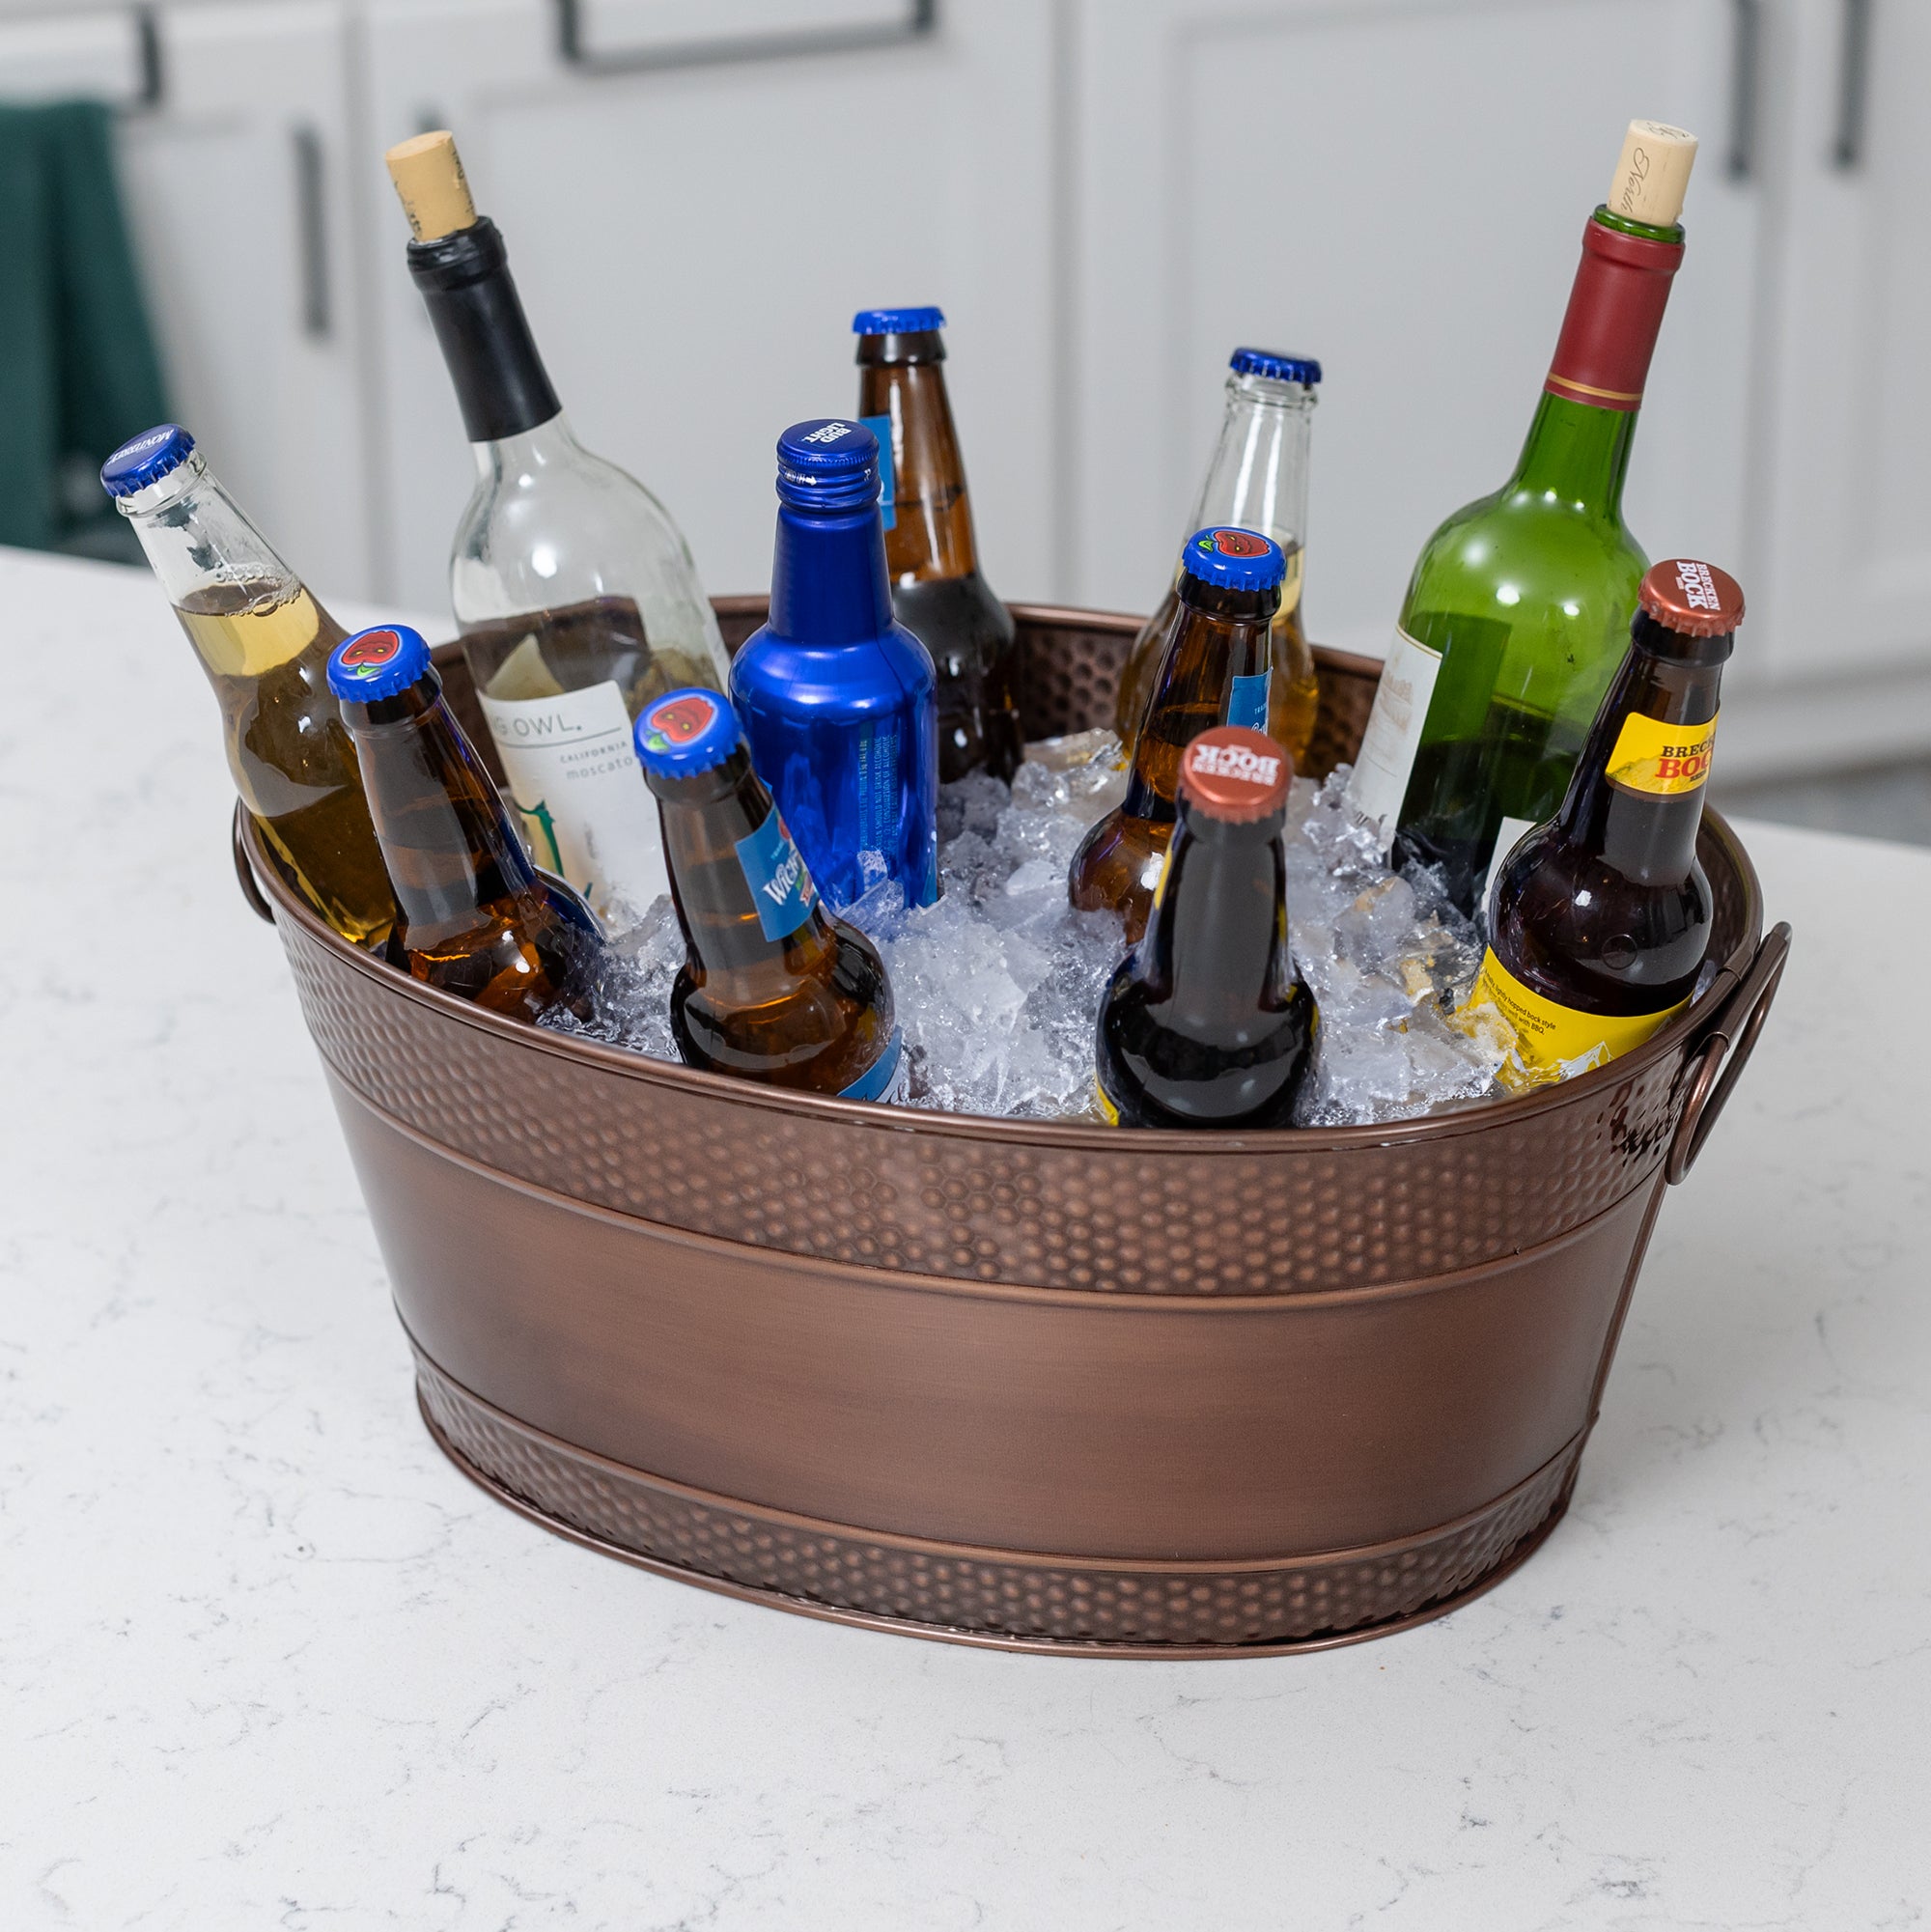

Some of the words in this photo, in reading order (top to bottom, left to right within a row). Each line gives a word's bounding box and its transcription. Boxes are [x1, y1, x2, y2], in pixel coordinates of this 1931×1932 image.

[801, 422, 846, 443] LIGHT
[820, 429, 852, 443] BUD
[1676, 561, 1708, 609] BOCK
[1696, 563, 1721, 611] BRECKEN
[560, 741, 627, 764] CALIFORNIA
[566, 756, 633, 780] moscato
[1508, 997, 1527, 1016] hopped
[1526, 1010, 1541, 1023] bock
[1542, 1019, 1556, 1030] style
